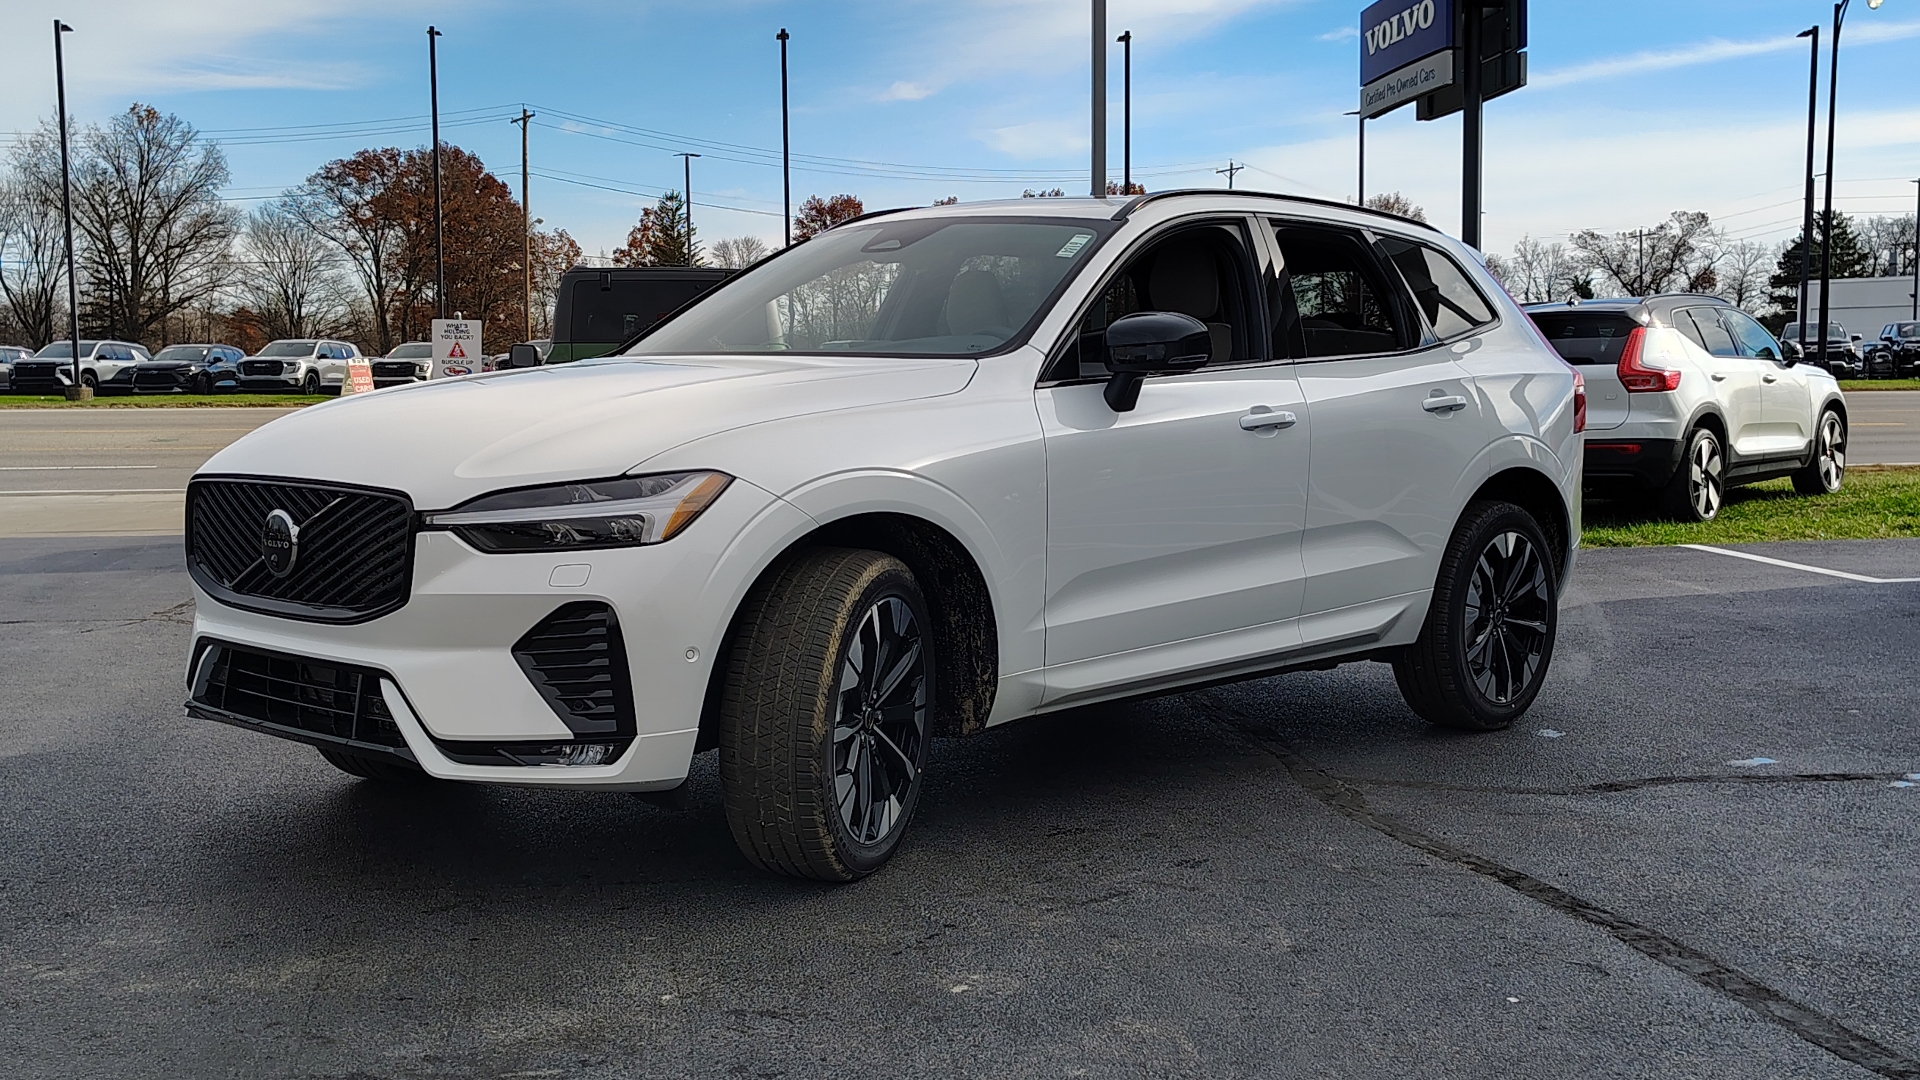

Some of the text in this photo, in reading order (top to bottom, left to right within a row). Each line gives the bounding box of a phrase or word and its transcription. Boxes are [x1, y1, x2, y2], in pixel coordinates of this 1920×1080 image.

[1365, 0, 1435, 56] VOLVO
[1366, 68, 1436, 107] Certified Pre Owned Cars
[354, 376, 371, 384] USED
[355, 385, 373, 393] CARS
[263, 539, 290, 549] VOLVO
